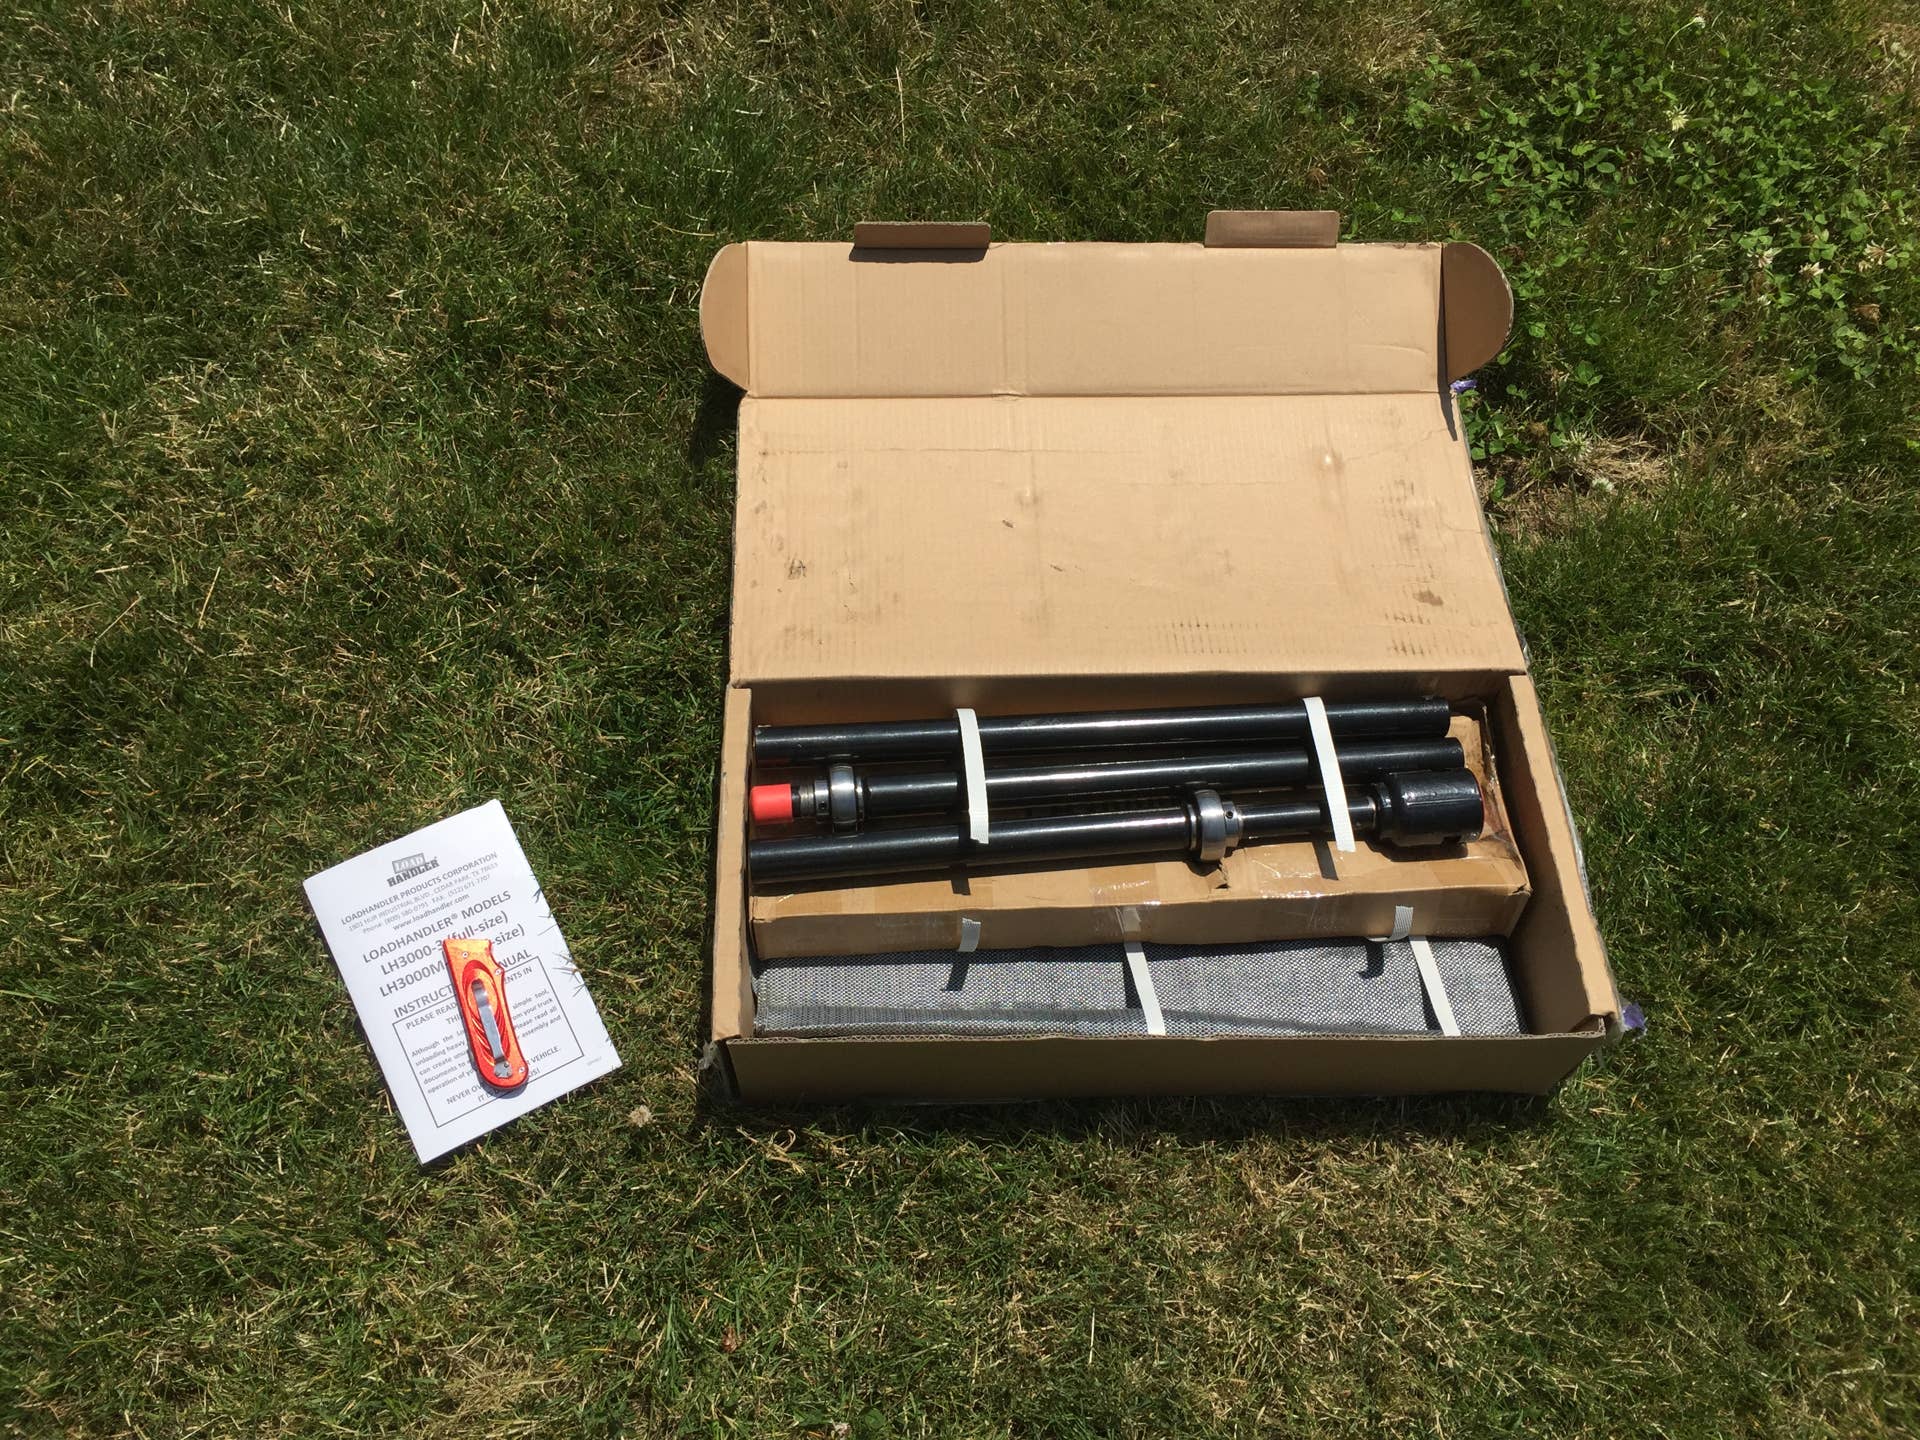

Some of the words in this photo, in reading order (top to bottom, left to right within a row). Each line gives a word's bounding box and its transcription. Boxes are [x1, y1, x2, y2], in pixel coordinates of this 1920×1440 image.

[387, 860, 440, 887] HANDLER
[393, 854, 427, 874] LOAD
[341, 895, 400, 926] LOADHANDLER
[400, 876, 442, 899] PRODUCTS
[442, 852, 498, 881] CORPORATION
[378, 900, 414, 919] INDUSTRIAL
[434, 881, 454, 895] CEDAR
[448, 886, 465, 898] (512)
[461, 891, 512, 920] MODELS
[393, 894, 470, 931] www.loadhandler.com
[381, 940, 446, 976] LH3000-3
[447, 911, 509, 942] full-size)
[490, 922, 526, 949] -size)
[394, 983, 456, 1019] INSTRUCT
[497, 950, 532, 971] NUAL
[406, 1012, 435, 1030] PLEASE
[435, 1000, 459, 1016] READ
[523, 967, 533, 975] IN
[412, 1041, 441, 1058] Although
[443, 1035, 454, 1043] the
[512, 997, 533, 1010] simple
[415, 1049, 447, 1067] unloading
[446, 1040, 466, 1052] heavy
[523, 1005, 537, 1017] your
[537, 998, 554, 1009] truck
[446, 1013, 463, 1025] THI
[419, 1068, 431, 1076] can
[432, 1057, 452, 1070] create
[534, 1010, 549, 1021] read
[423, 1066, 458, 1086] documents
[522, 1022, 549, 1038] assembly
[550, 1015, 562, 1025] and
[428, 1077, 459, 1094] operation
[458, 1071, 466, 1080] of
[446, 1089, 472, 1105] NEVER
[531, 1046, 561, 1064] VEHICLE.
[477, 1094, 486, 1103] IT
